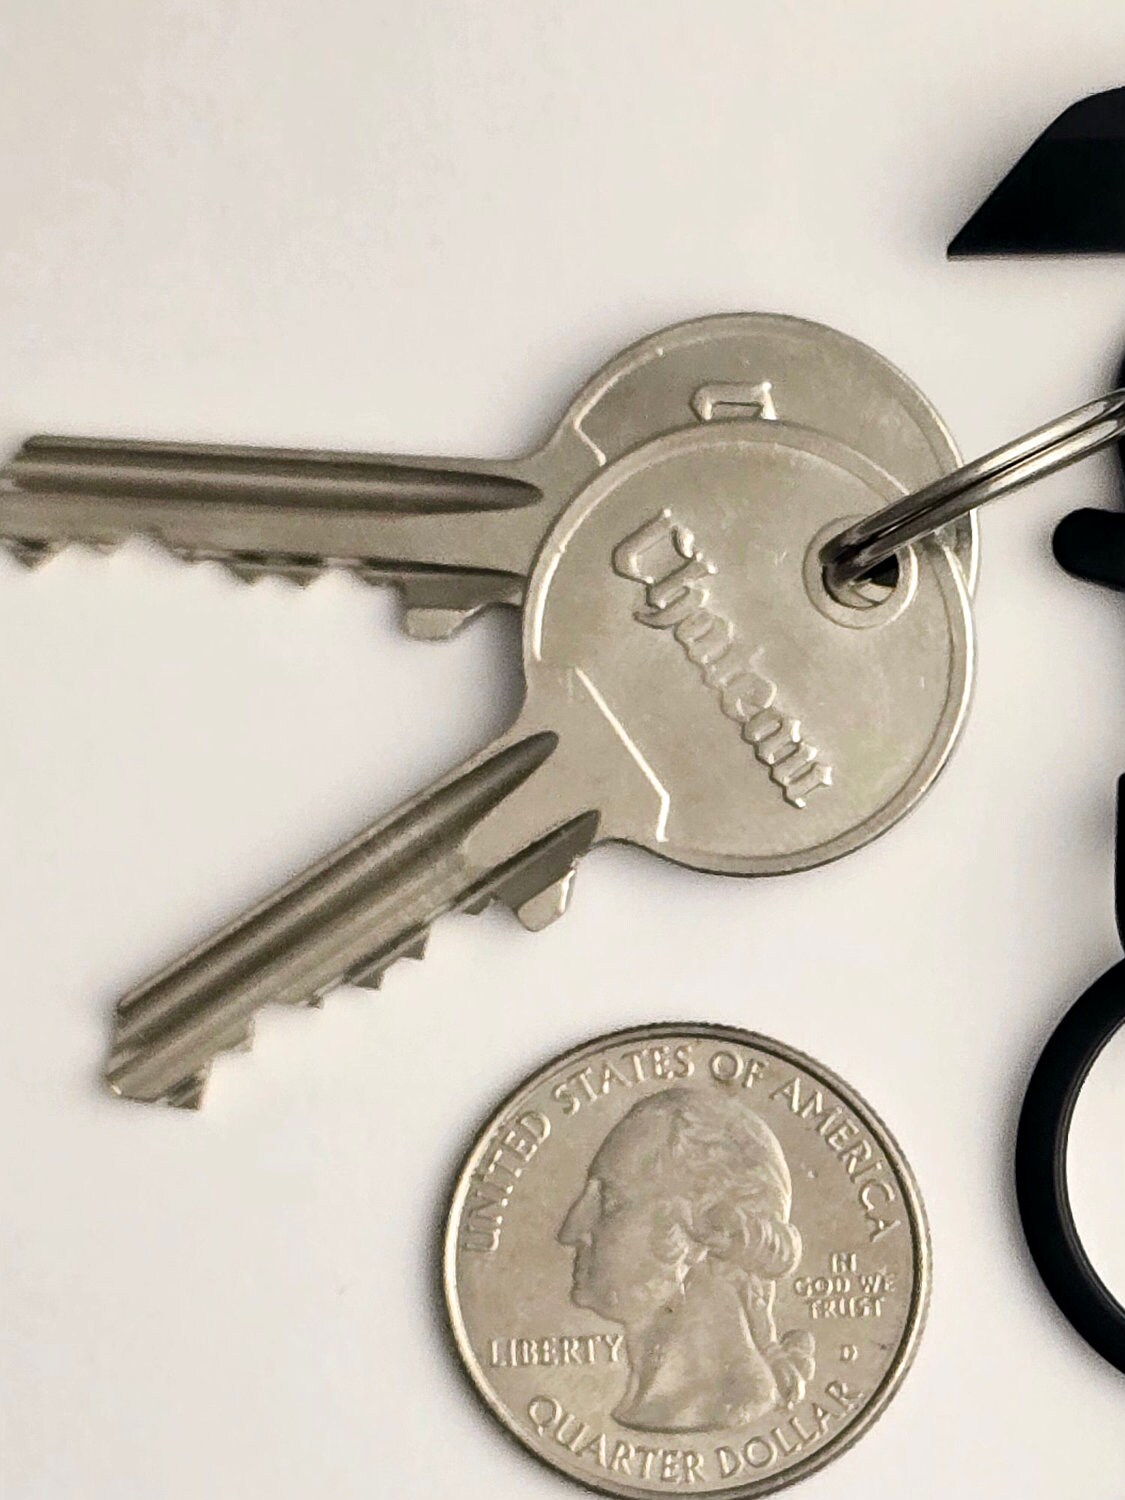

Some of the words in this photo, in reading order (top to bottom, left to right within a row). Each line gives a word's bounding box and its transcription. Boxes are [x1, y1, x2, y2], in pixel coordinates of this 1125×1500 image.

[462, 1107, 553, 1255] UNITED
[553, 1043, 696, 1116] STATES
[709, 1048, 770, 1089] OF
[768, 1076, 902, 1244] AMERICA
[792, 1274, 852, 1298] GOD
[856, 1273, 896, 1294] WE
[802, 1295, 886, 1319] TRUST
[488, 1332, 626, 1368] LIBERTY
[526, 1393, 706, 1484] QUARTER
[712, 1377, 866, 1479] DOLLAR
